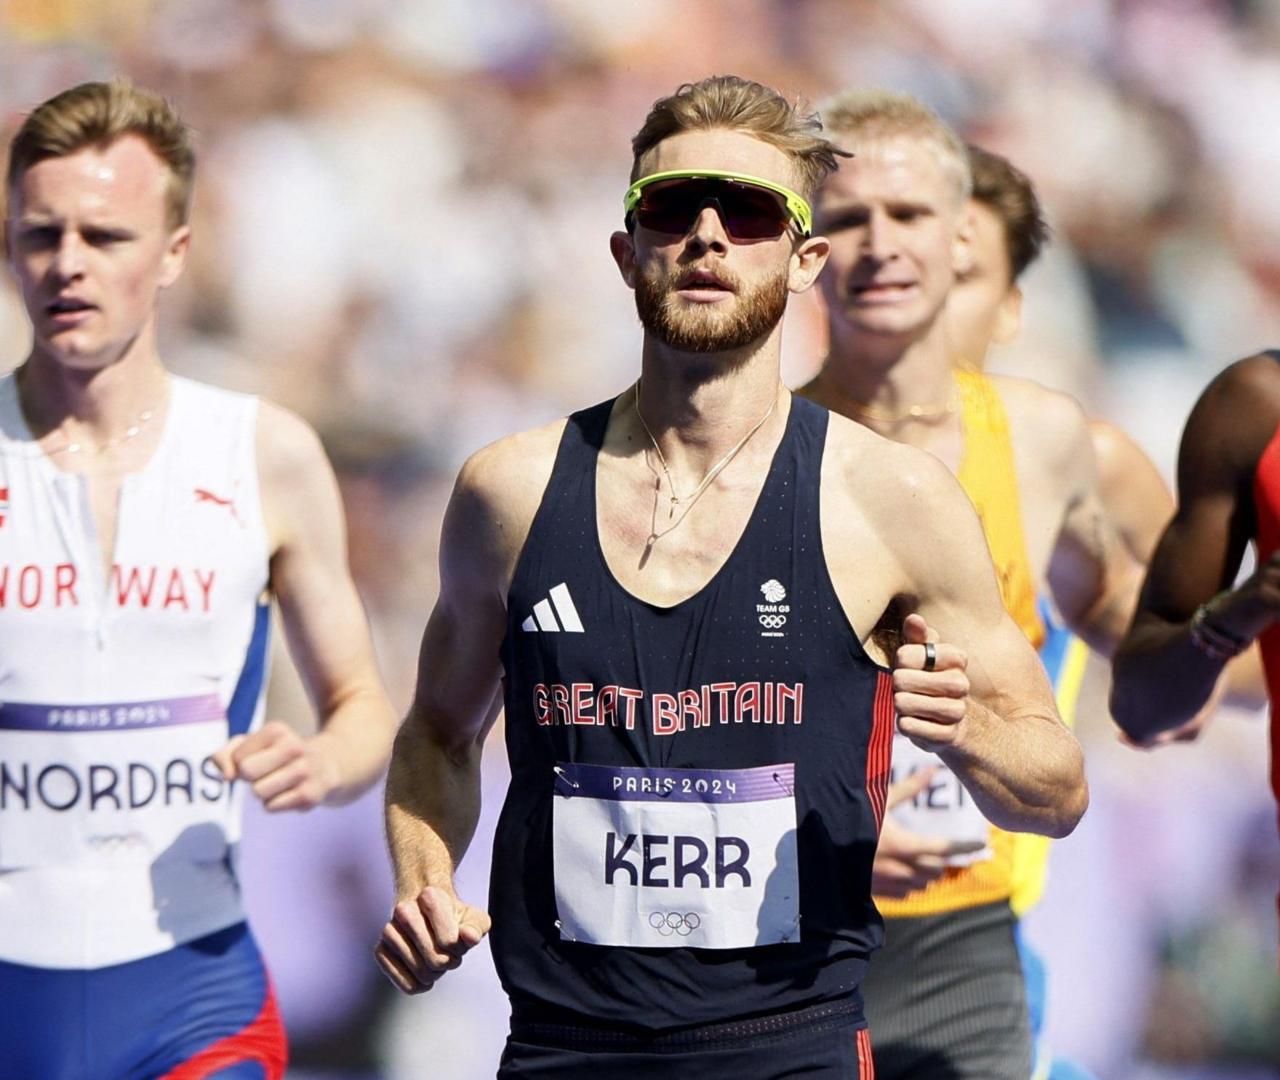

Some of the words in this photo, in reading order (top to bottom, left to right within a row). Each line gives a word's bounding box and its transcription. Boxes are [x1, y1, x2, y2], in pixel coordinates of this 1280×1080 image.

[756, 604, 777, 613] TEAM
[778, 604, 790, 613] GB
[47, 708, 111, 727] PARIS
[115, 705, 171, 726] 2024
[533, 683, 643, 730] GREAT
[652, 682, 804, 735] BRITAIN
[0, 756, 224, 811] NORDAS
[613, 776, 674, 793] PARIS
[682, 778, 736, 794] 2024
[604, 831, 752, 888] KERR
